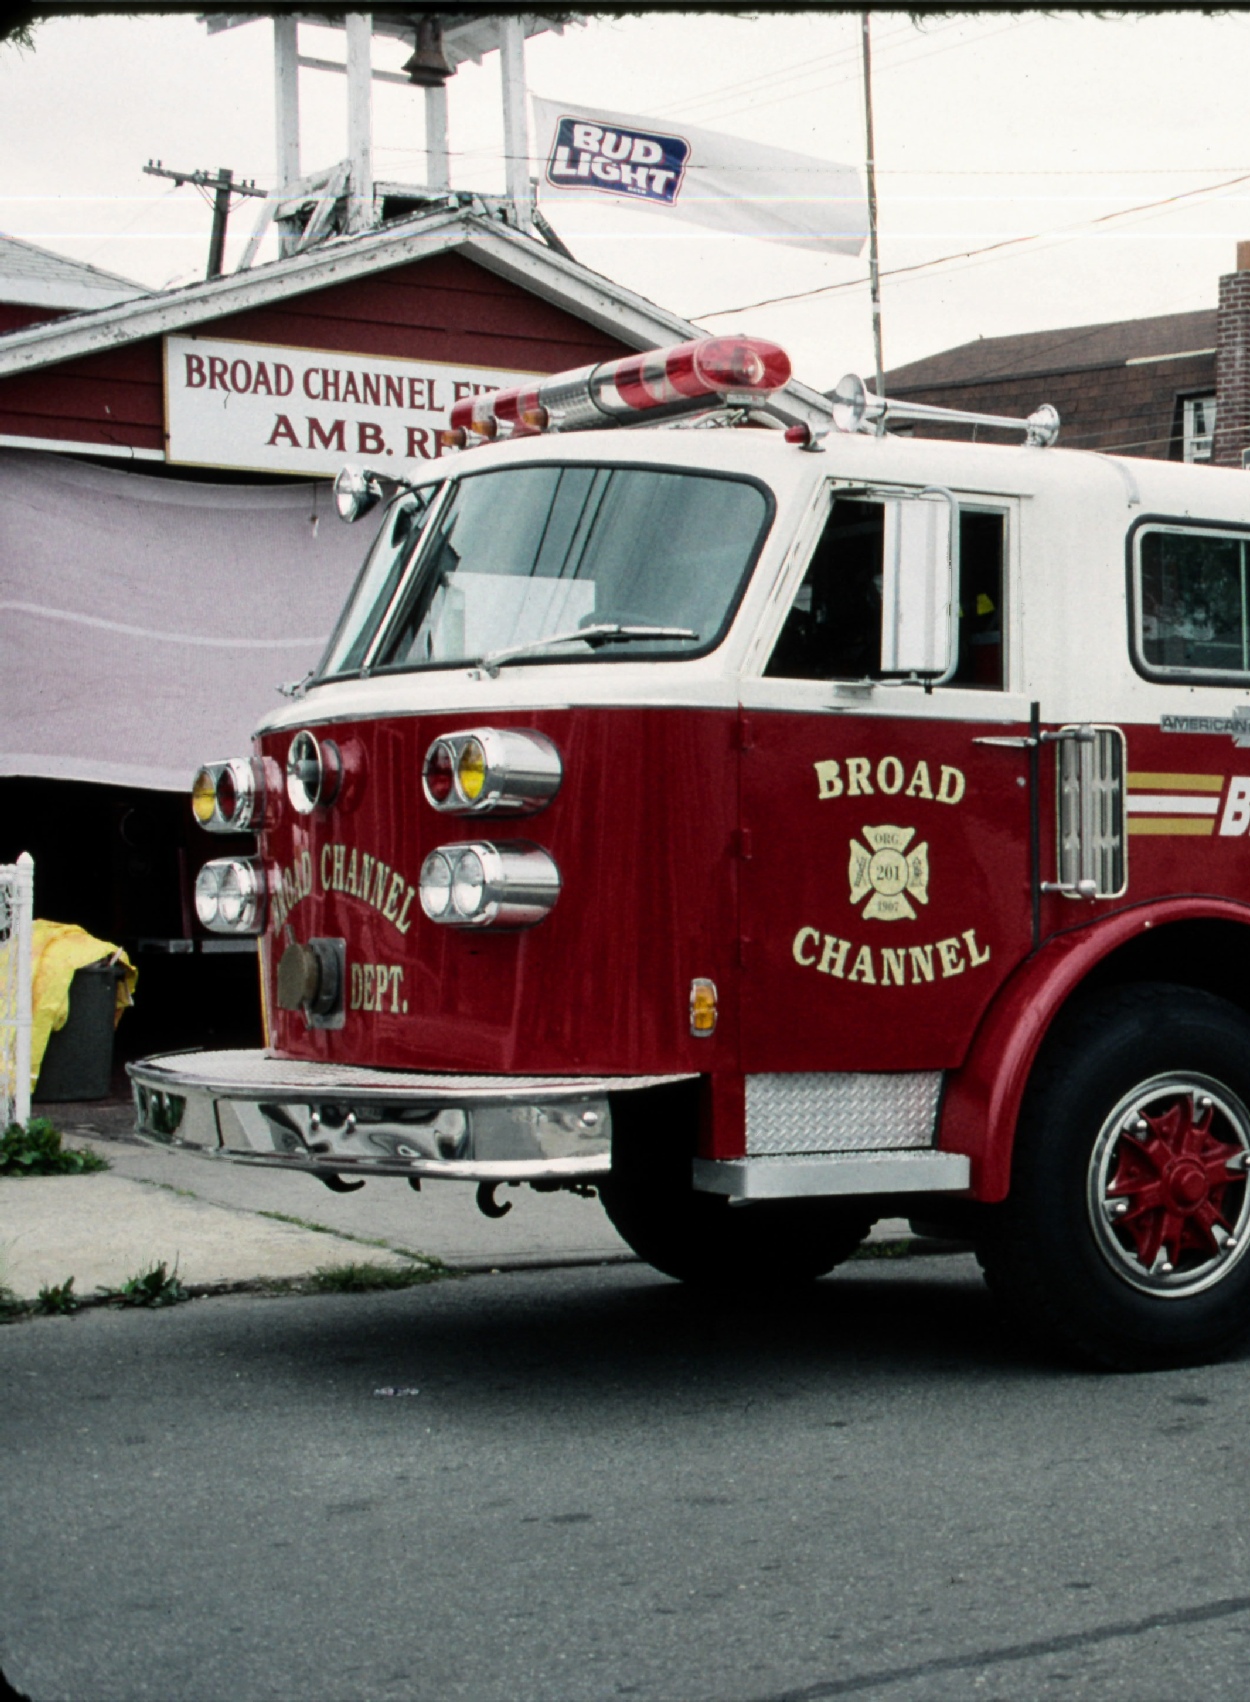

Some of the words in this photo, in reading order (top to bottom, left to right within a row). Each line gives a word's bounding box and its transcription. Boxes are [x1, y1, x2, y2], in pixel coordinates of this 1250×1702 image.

[573, 123, 663, 164] BUD
[553, 146, 675, 195] LIGHT
[185, 353, 294, 397] BROAD
[303, 367, 445, 413] CHANNEL
[265, 414, 394, 457] AMB.
[1162, 715, 1246, 733] AMERICAN
[813, 756, 965, 805] BROAD
[320, 843, 415, 935] CHANNEL
[876, 865, 899, 881] 201
[792, 925, 990, 986] CHANNEL
[351, 963, 408, 1014] DEPT.
